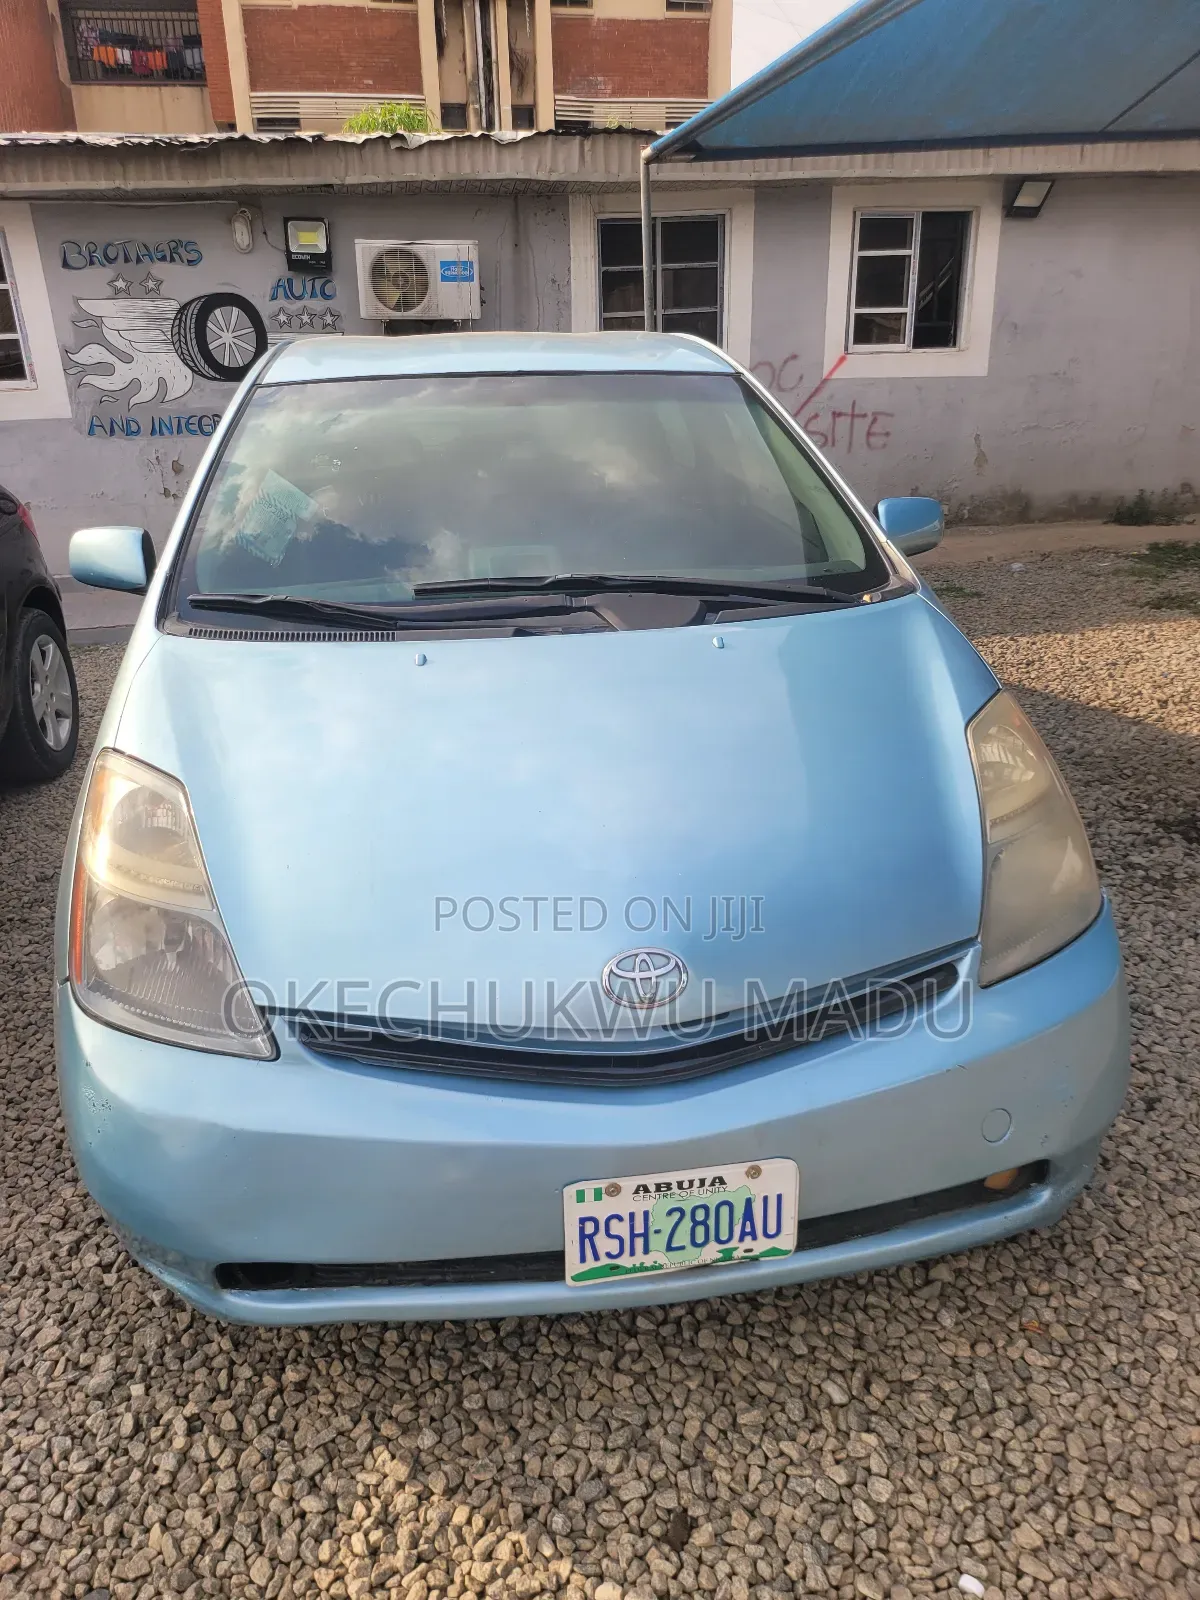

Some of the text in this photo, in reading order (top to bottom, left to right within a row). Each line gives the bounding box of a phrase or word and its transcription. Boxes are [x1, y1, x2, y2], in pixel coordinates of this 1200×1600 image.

[270, 277, 336, 301] AUTO
[88, 415, 141, 437] AND
[803, 400, 895, 454] SITE
[632, 1176, 728, 1195] ABUJA
[632, 1186, 728, 1202] CENTRE OF UNITY
[578, 1193, 783, 1264] RSH-280AU
